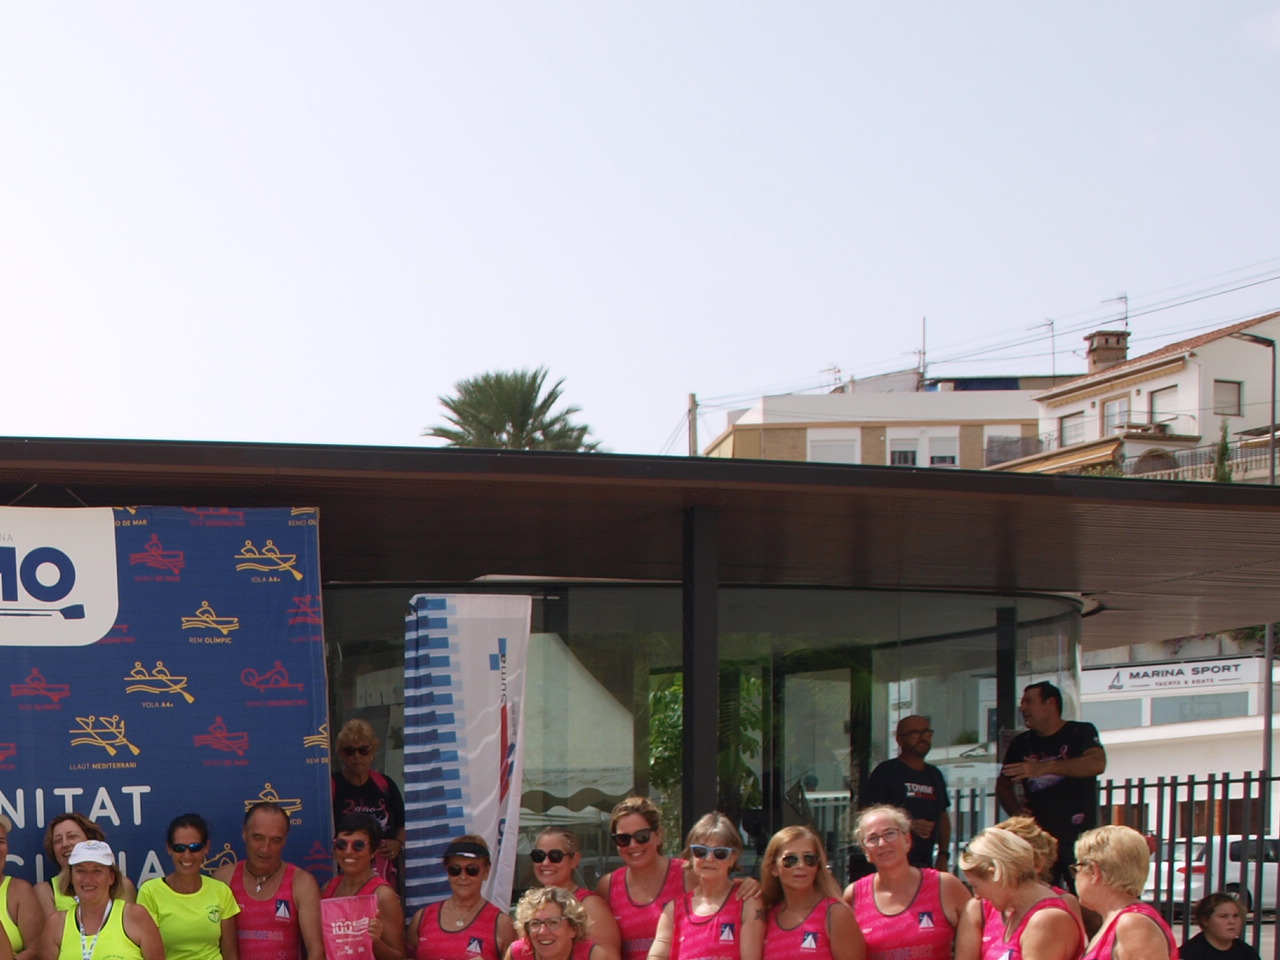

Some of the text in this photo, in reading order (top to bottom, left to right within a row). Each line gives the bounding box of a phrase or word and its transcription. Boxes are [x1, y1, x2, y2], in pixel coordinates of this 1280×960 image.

[288, 519, 306, 527] REMO
[1129, 663, 1242, 680] MARINA SPORT
[141, 701, 160, 709] YOLA
